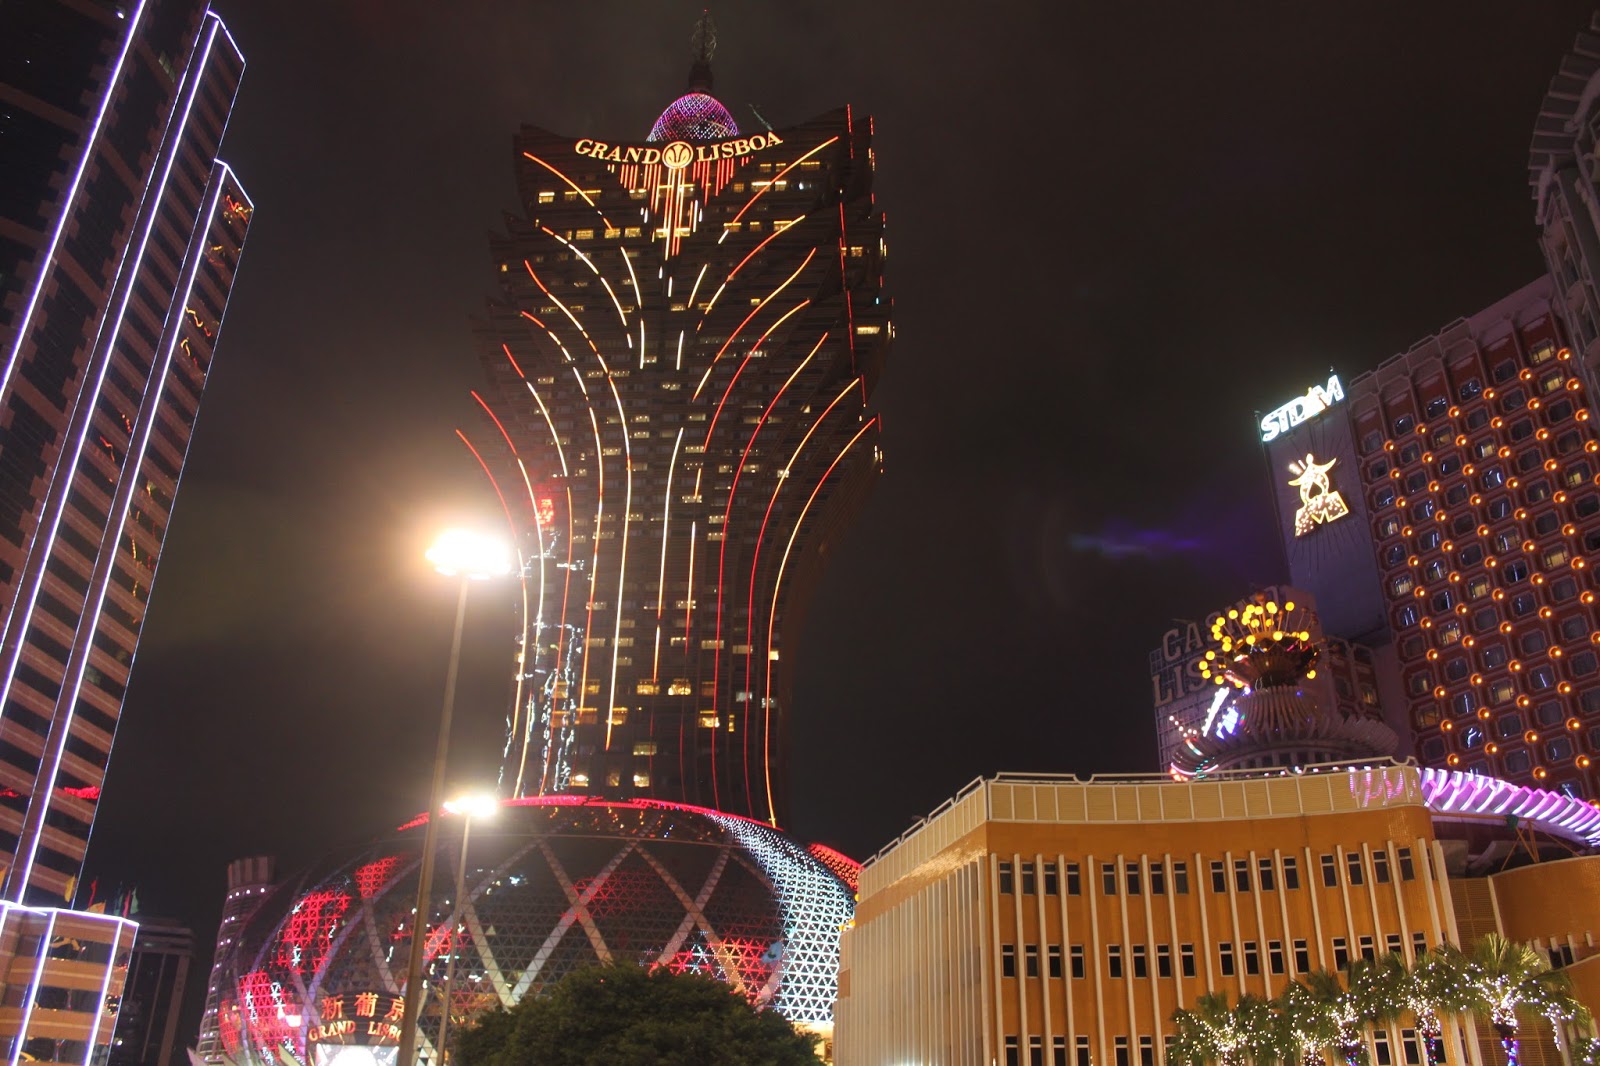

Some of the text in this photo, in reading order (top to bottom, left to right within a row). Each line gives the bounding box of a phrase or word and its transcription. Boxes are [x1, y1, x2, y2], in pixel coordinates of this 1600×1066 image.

[574, 131, 784, 165] GRAND LISBOA
[320, 991, 405, 1022] 新葡京
[308, 1020, 402, 1043] GRAND LISB
